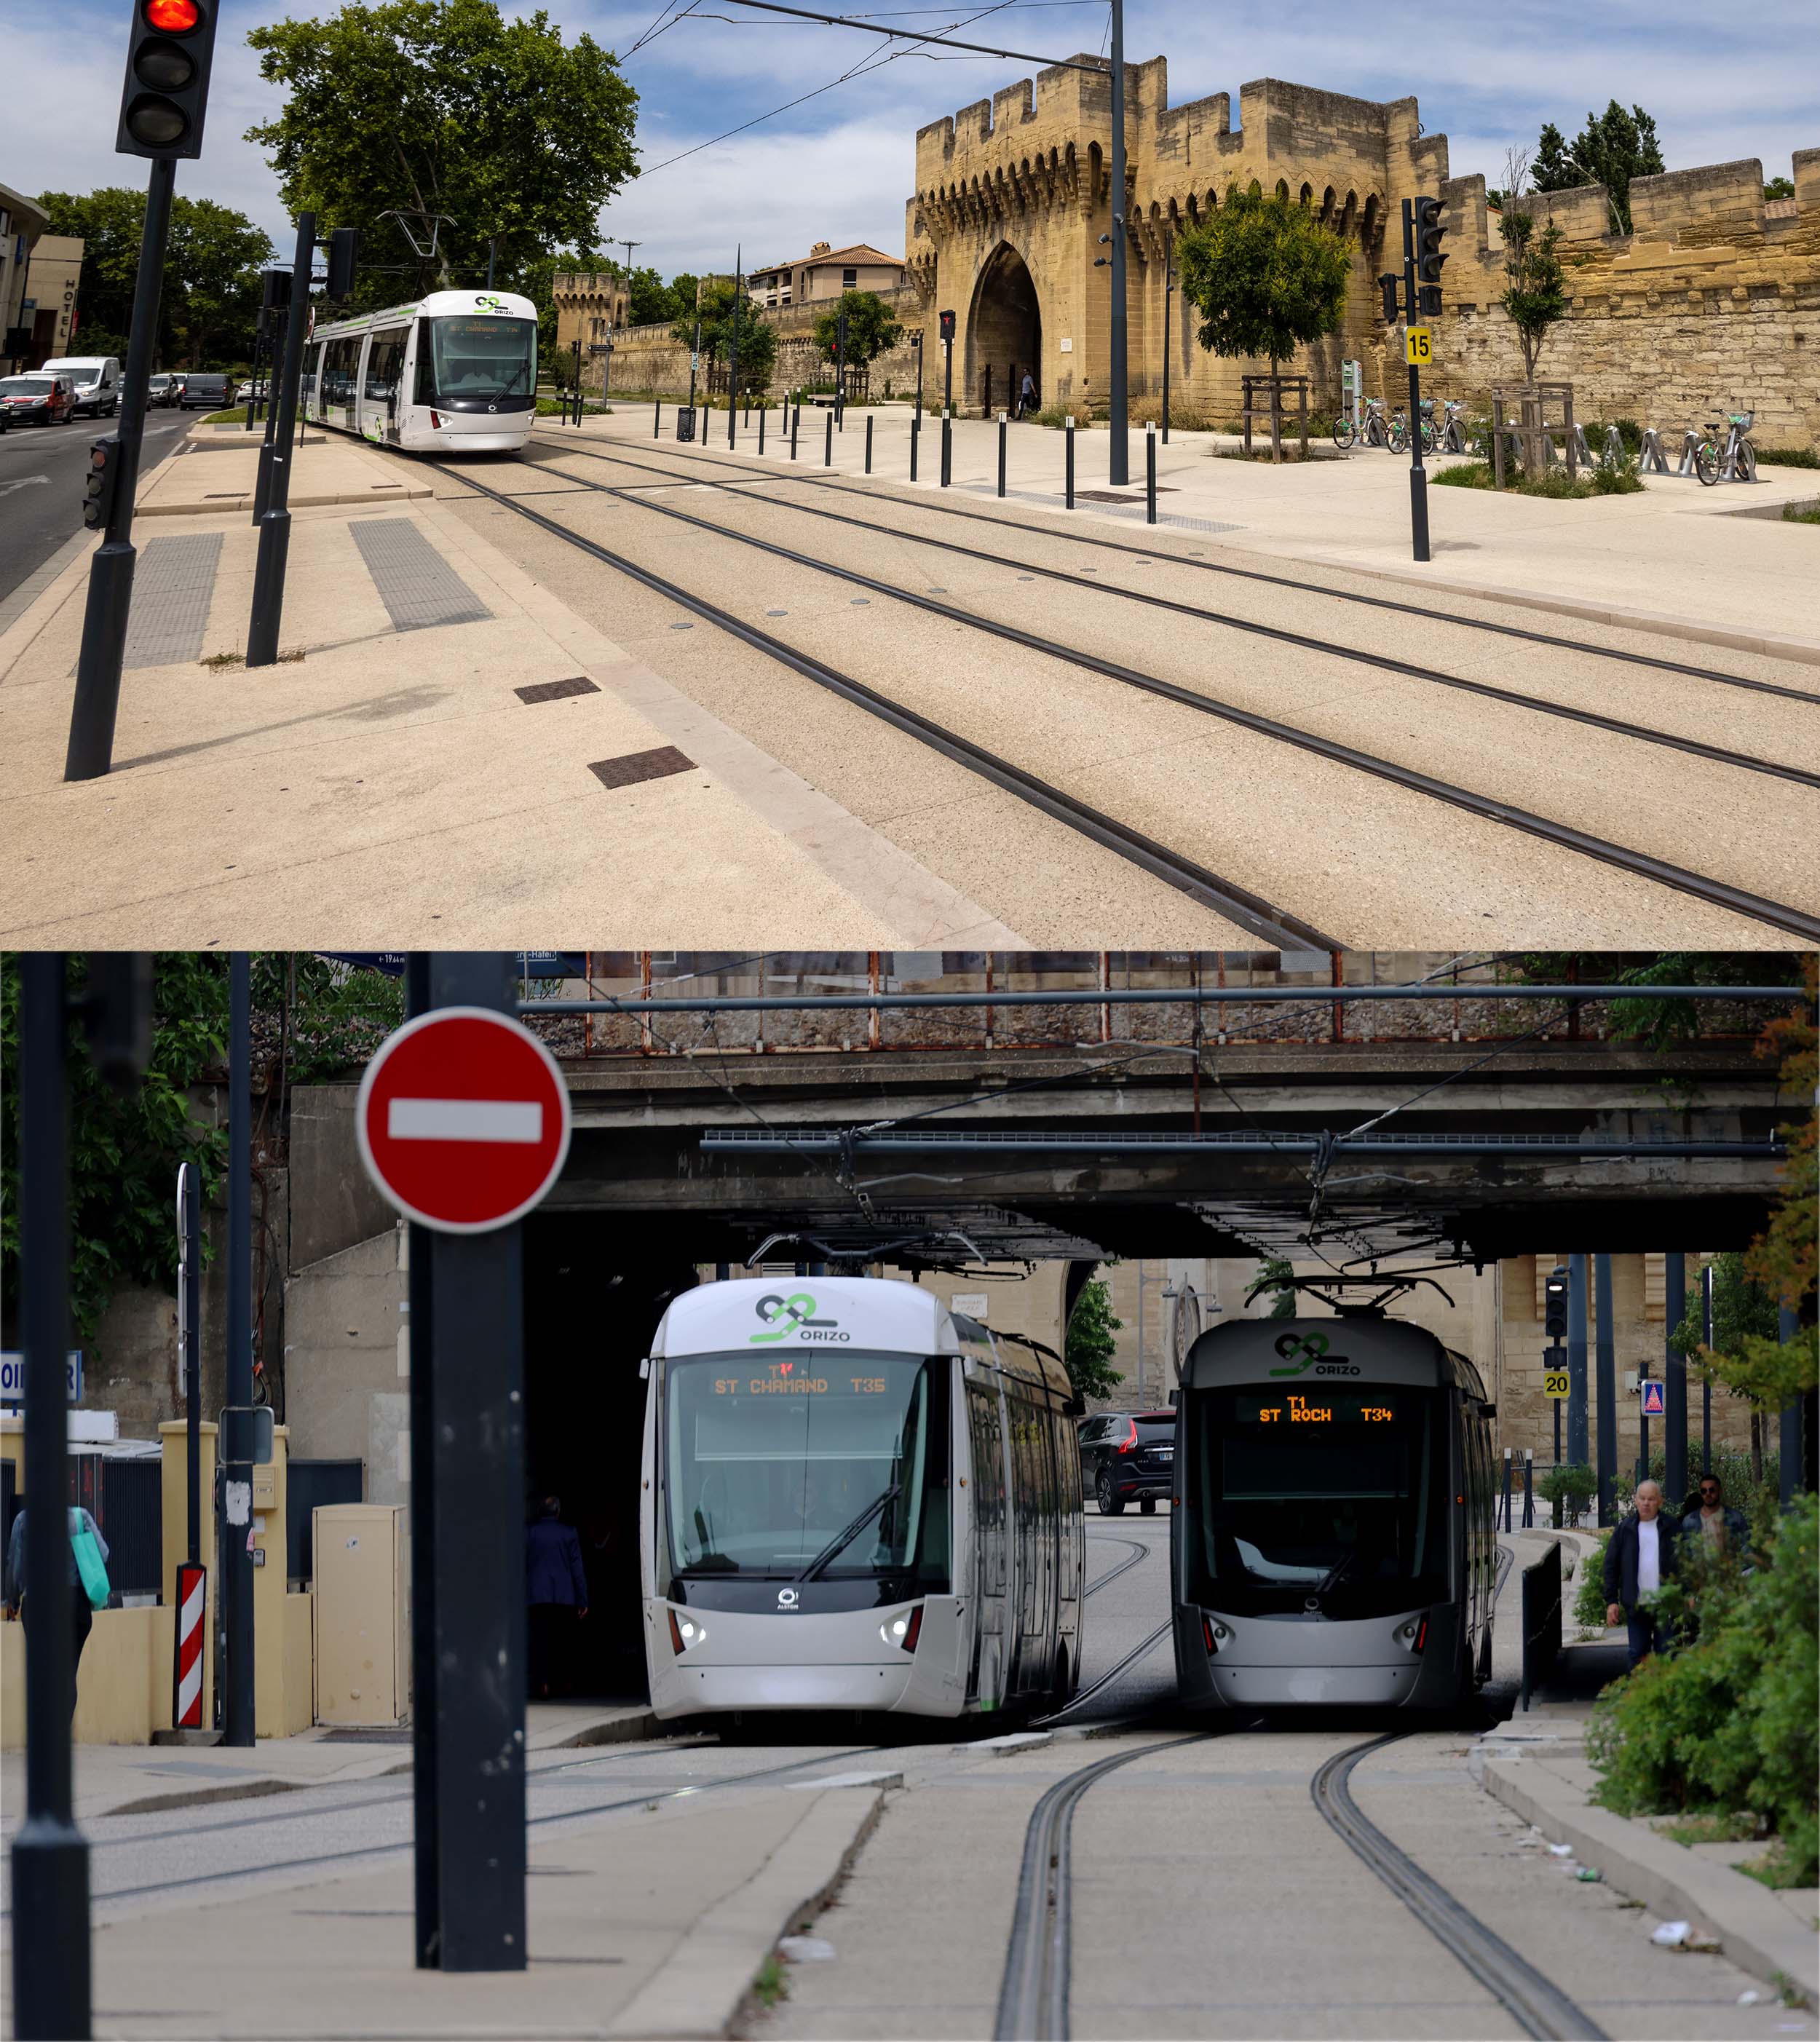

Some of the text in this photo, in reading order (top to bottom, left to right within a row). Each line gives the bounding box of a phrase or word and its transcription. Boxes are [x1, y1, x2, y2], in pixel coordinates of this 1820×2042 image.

[60, 280, 75, 337] HOTEL
[1409, 335, 1429, 356] 15
[801, 1331, 850, 1342] ORIZO
[1315, 1366, 1361, 1375] ORIZO
[716, 1379, 885, 1393] ST CHAMAND T35
[1547, 1377, 1567, 1392] 20
[1287, 1396, 1305, 1409] T1
[1259, 1408, 1392, 1422] ST ROCH T34
